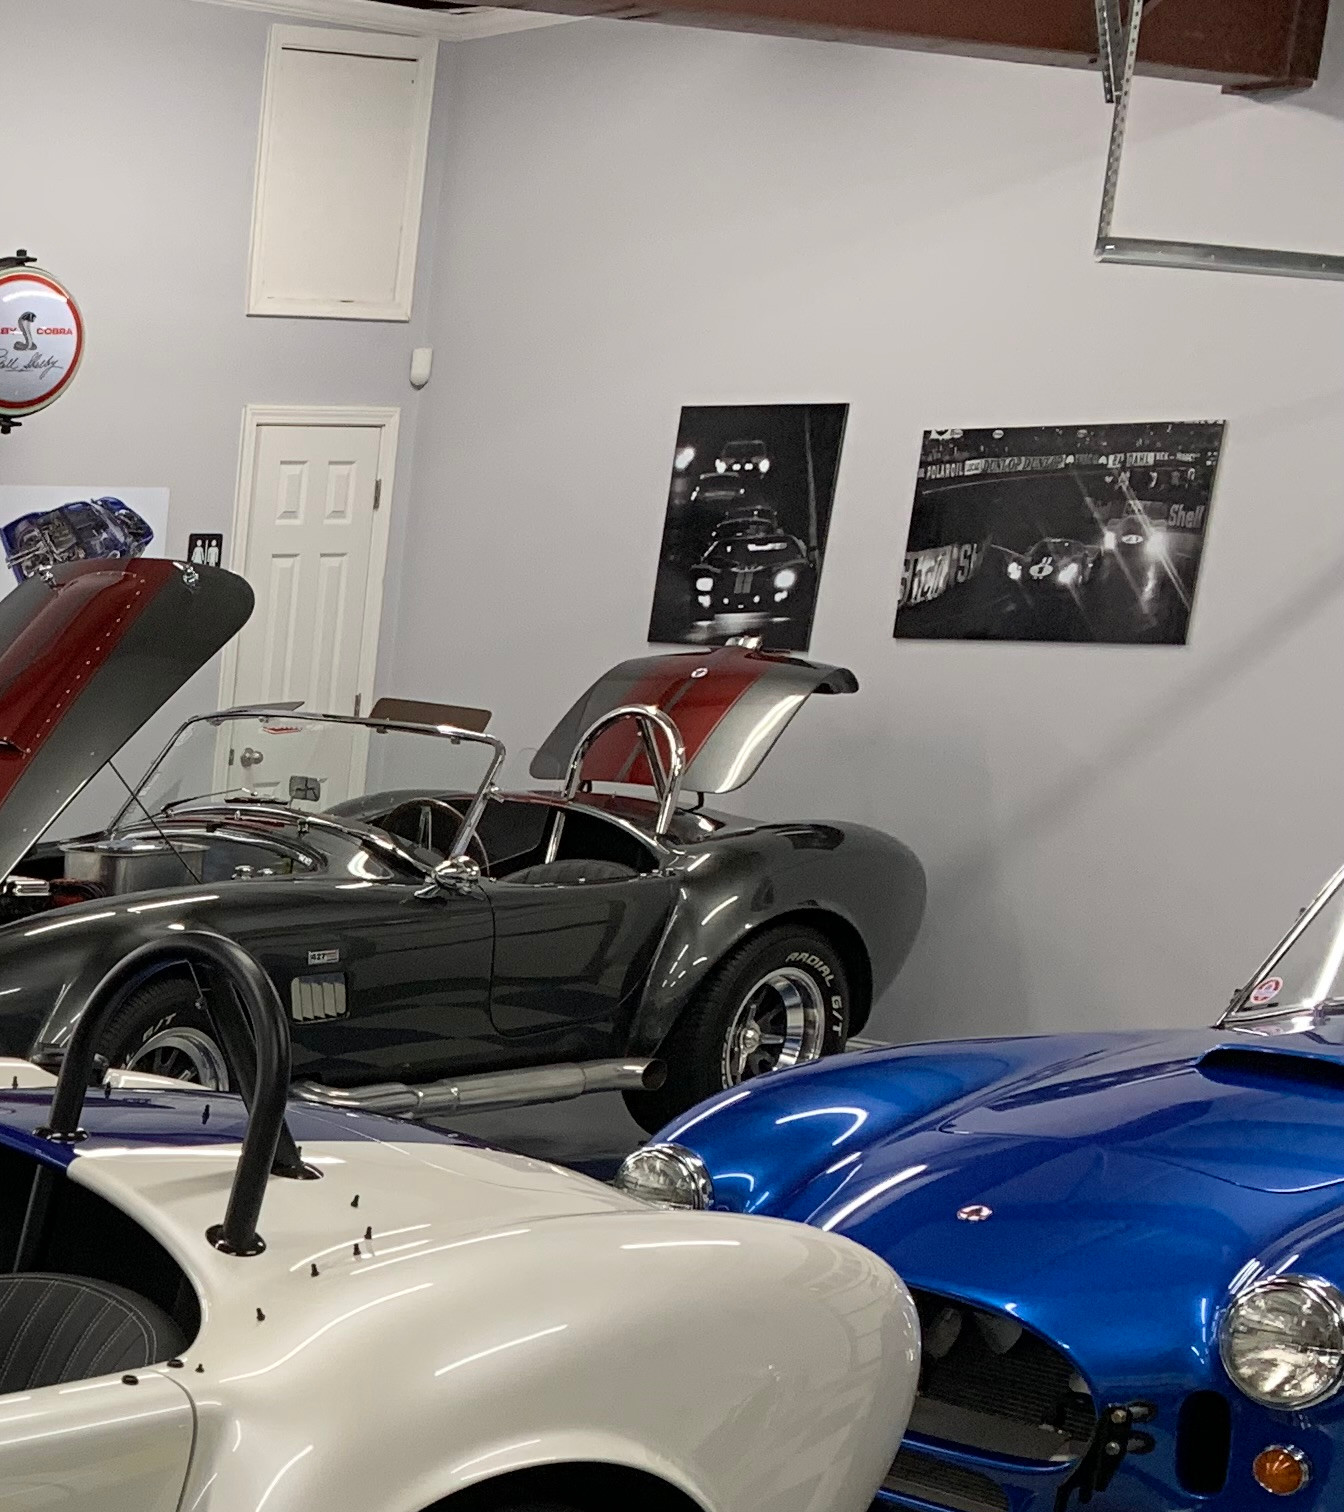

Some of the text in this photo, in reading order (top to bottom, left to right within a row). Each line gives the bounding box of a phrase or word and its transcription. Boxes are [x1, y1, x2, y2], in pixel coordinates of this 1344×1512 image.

[36, 326, 73, 336] COBRA
[1169, 503, 1205, 528] Shell
[785, 952, 844, 1037] RADIAL G/T
